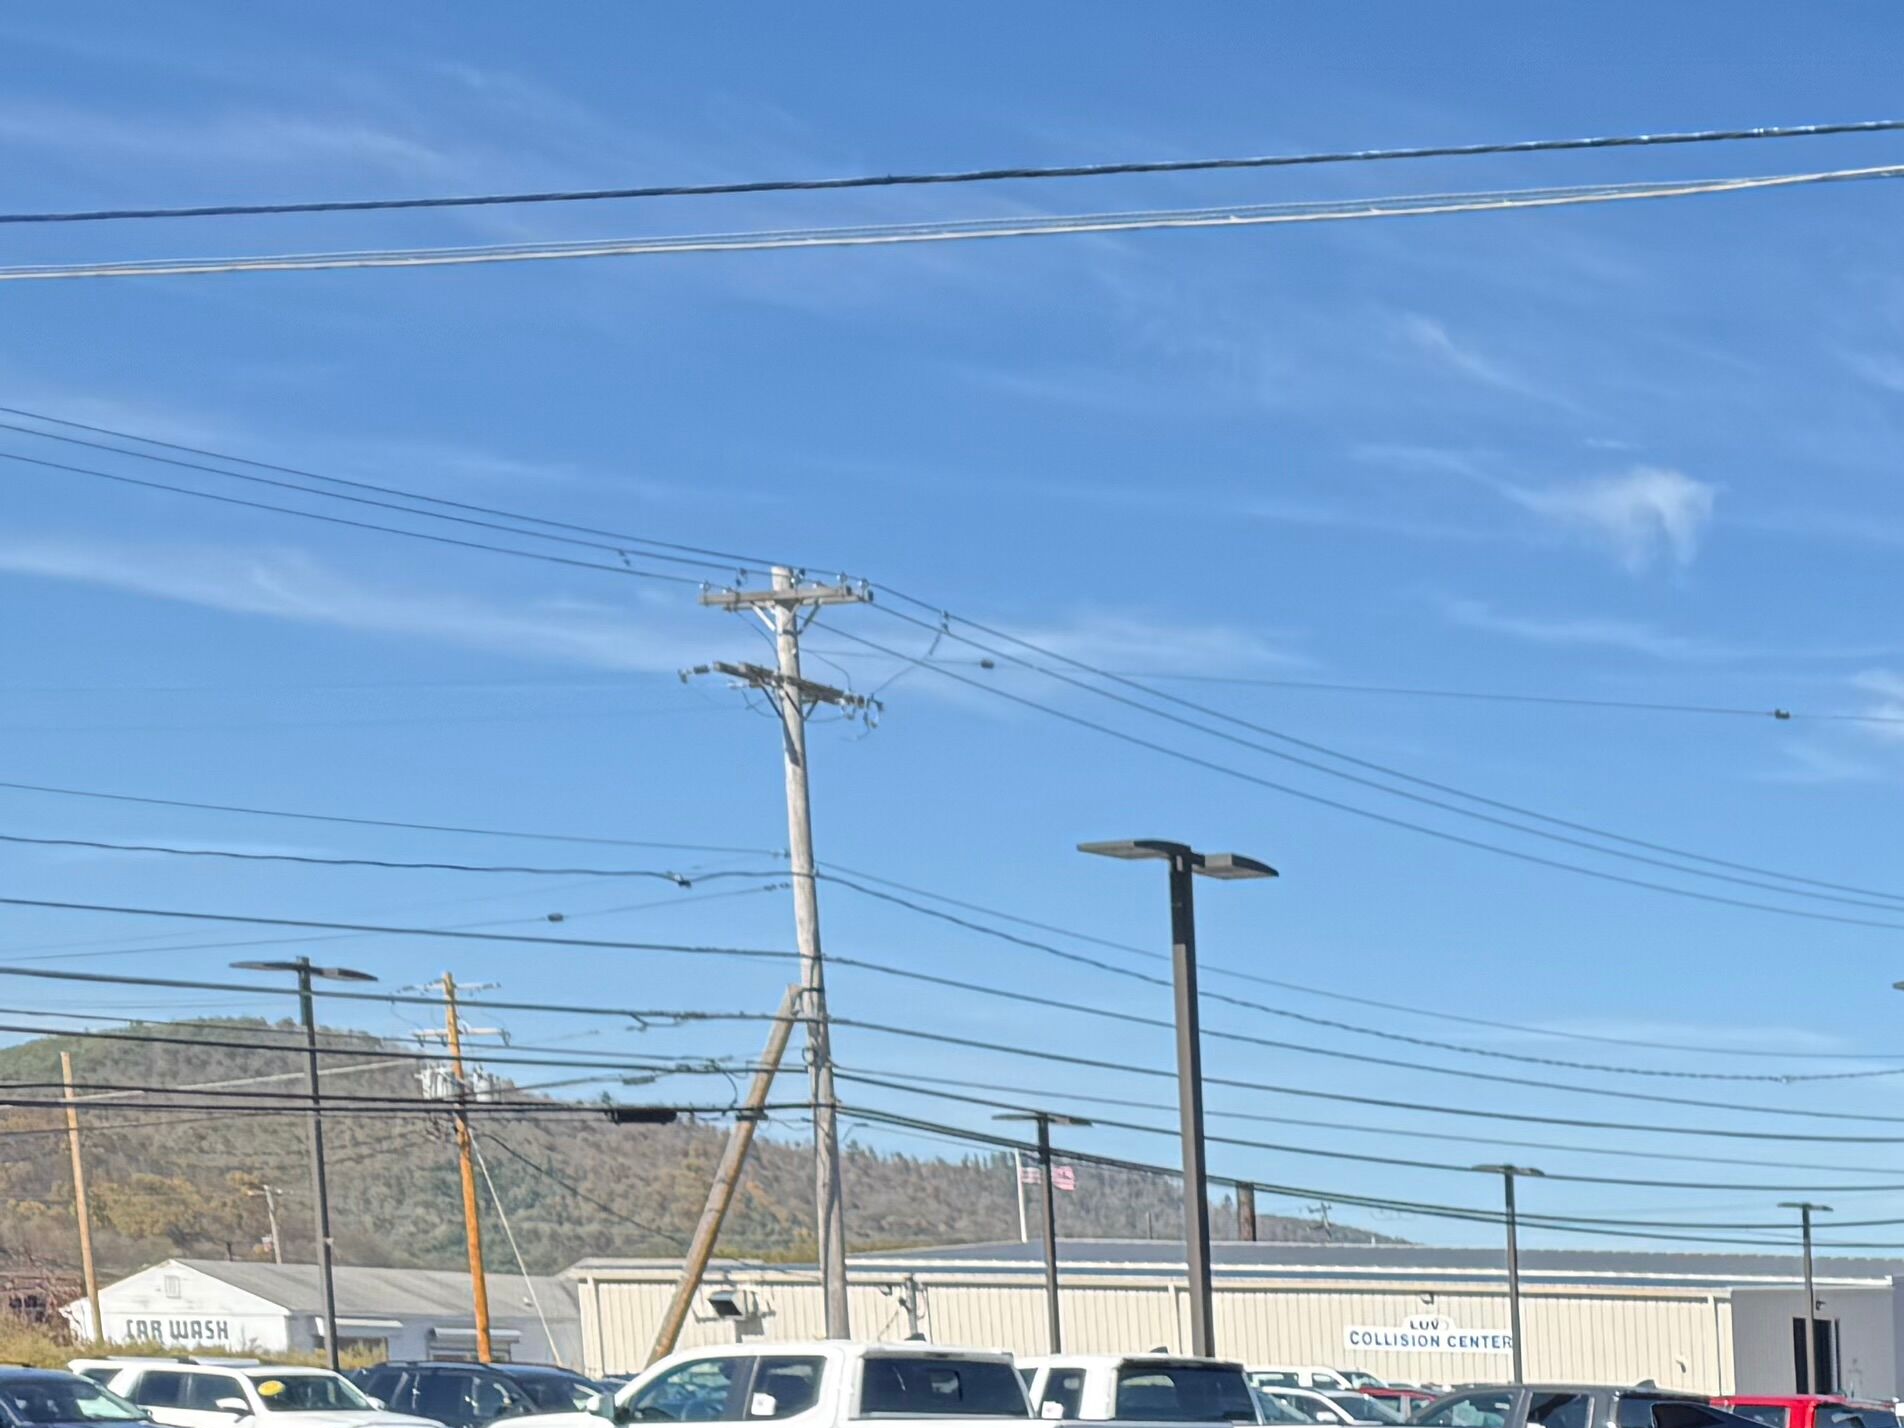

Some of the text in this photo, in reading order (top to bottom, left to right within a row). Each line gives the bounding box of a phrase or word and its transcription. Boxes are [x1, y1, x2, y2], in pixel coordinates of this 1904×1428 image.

[126, 1319, 229, 1341] CAR WASH
[1349, 1330, 1513, 1349] COLLISION CENTER
